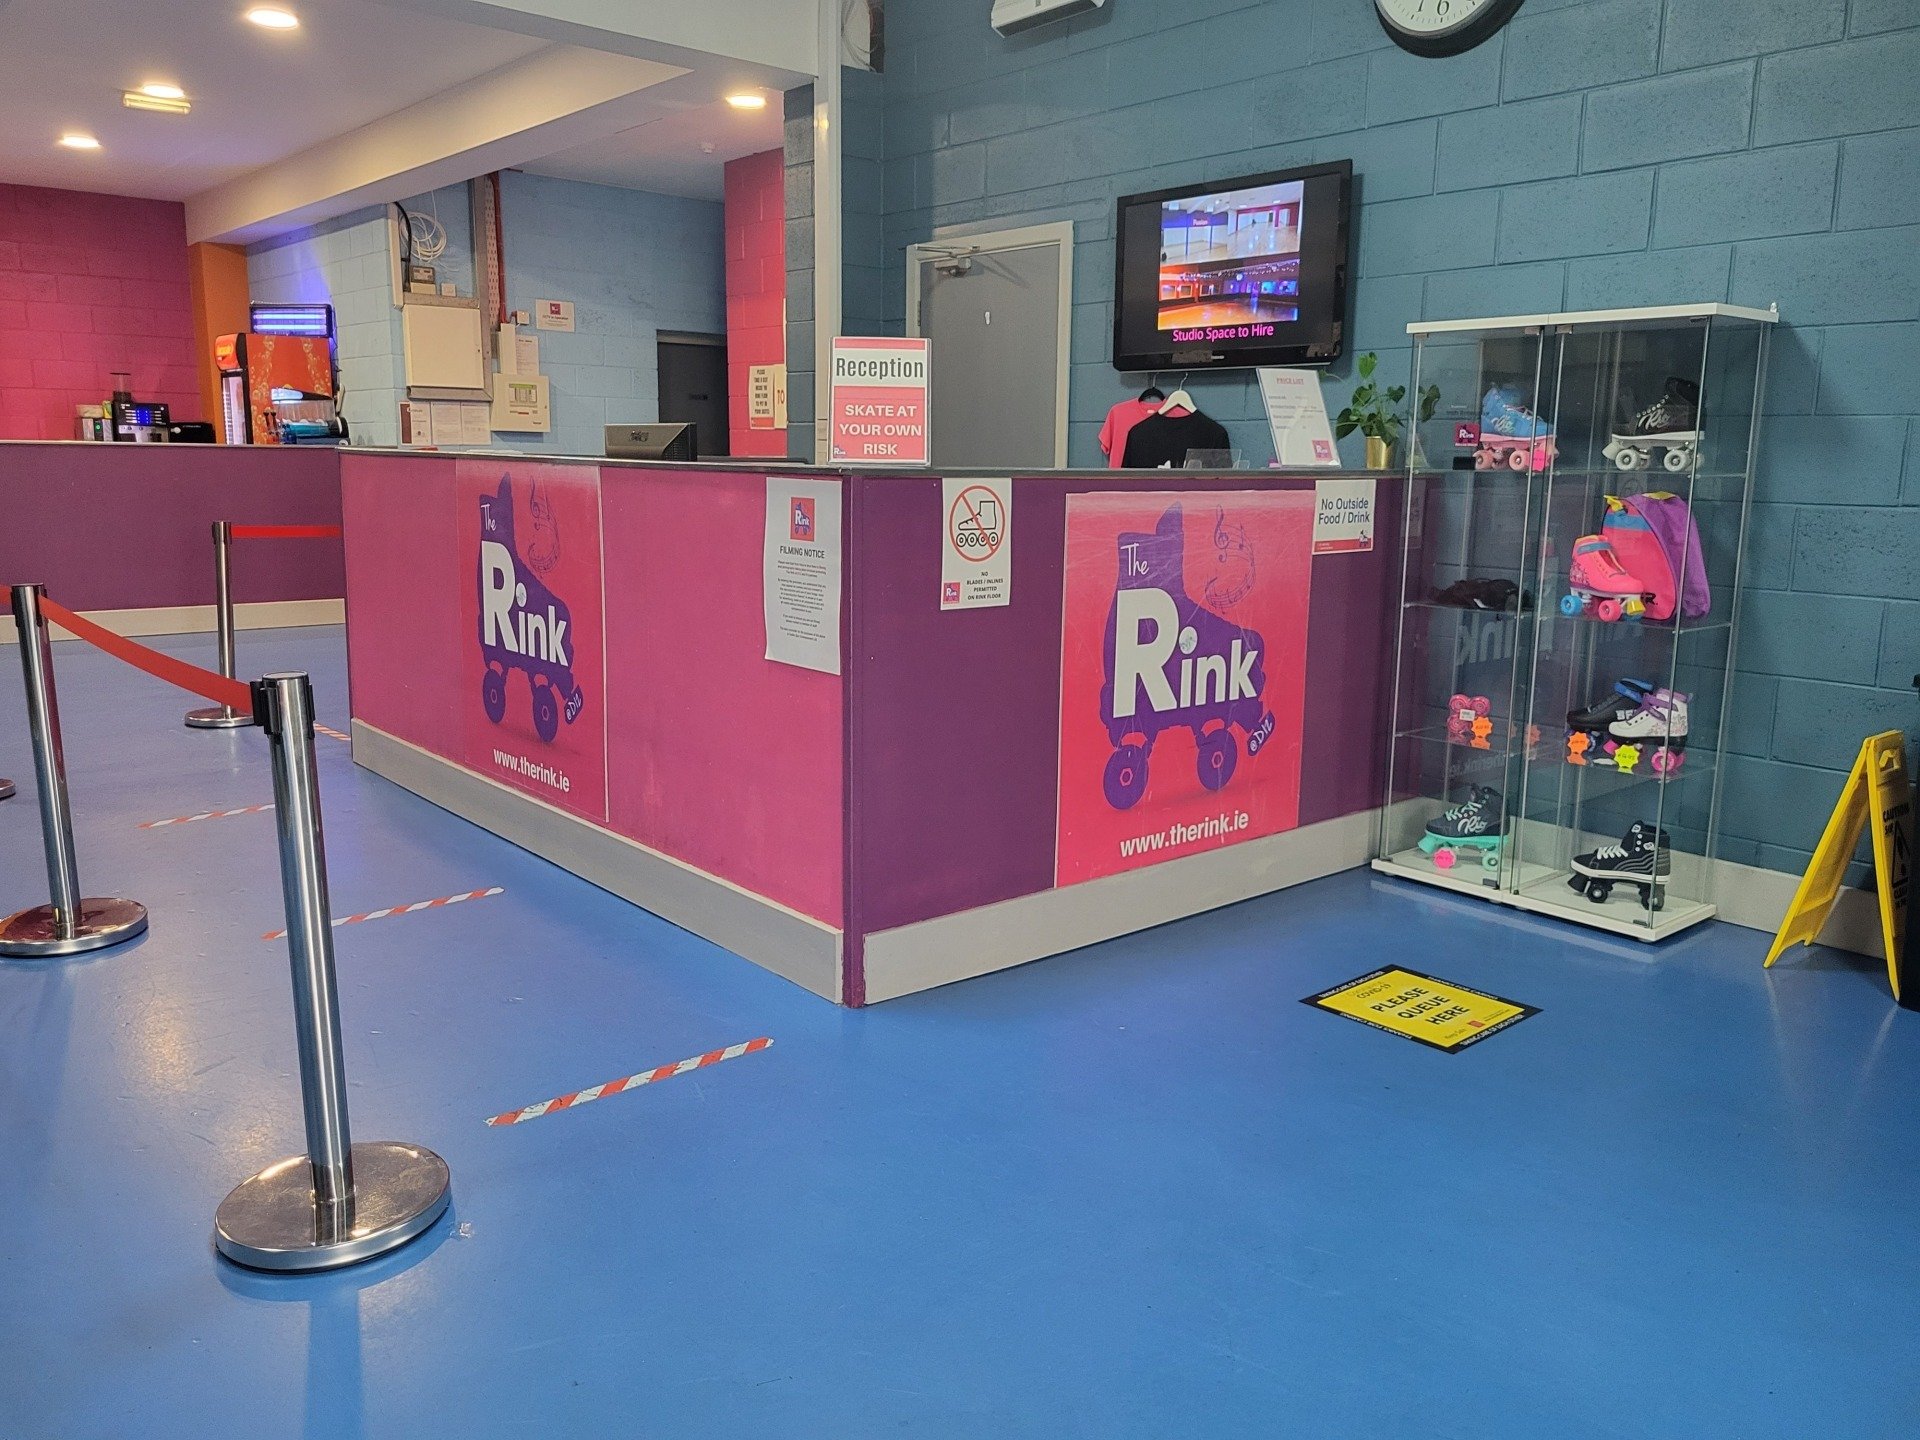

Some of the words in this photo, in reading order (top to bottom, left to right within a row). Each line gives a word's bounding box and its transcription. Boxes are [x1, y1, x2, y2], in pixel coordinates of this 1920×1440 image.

[1436, 0, 1450, 16] 6
[1172, 329, 1204, 342] Studio
[1205, 327, 1236, 342] Space
[1238, 326, 1249, 338] to
[1251, 323, 1274, 337] Hire
[836, 357, 924, 380] Reception
[845, 404, 894, 417] SKATE
[896, 405, 917, 417] AT
[839, 423, 881, 436] YOUR
[884, 424, 922, 437] OWN
[863, 443, 898, 456] RISK
[1321, 497, 1334, 511] No
[1336, 497, 1369, 511] Outside
[481, 503, 497, 531] The
[1318, 511, 1341, 525] Food
[1341, 511, 1347, 525] /
[1347, 511, 1370, 524] Drink
[780, 545, 803, 556] FILMING
[804, 548, 826, 559] NOTICE
[1120, 542, 1150, 577] The
[482, 540, 569, 667] Rink
[1113, 587, 1259, 719] Rink
[493, 748, 570, 793] www.therink.ie
[1120, 809, 1249, 858] www.therink.ie
[1457, 815, 1488, 835] Rio
[1370, 987, 1430, 1012] PLEASE
[1397, 995, 1451, 1019] QUEUE
[1425, 1005, 1471, 1025] HERE
